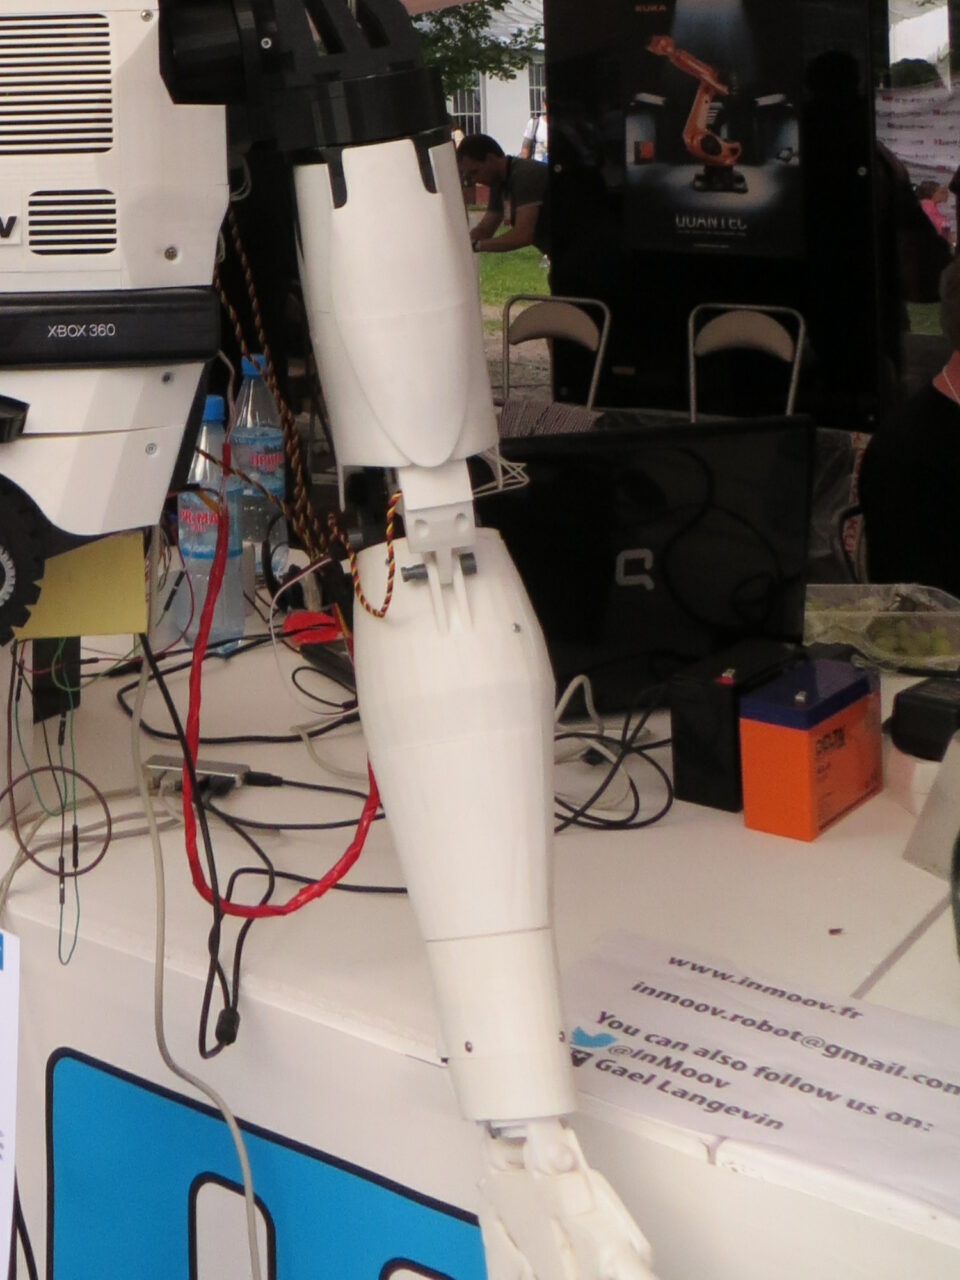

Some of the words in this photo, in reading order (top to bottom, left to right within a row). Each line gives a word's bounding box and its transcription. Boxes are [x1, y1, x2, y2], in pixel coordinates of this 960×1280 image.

[47, 324, 86, 339] XBOX
[88, 323, 116, 338] 360
[667, 954, 864, 1022] www.inmoov.fr
[594, 1056, 655, 1088] Gael
[655, 1077, 786, 1132] Langevin
[595, 1010, 640, 1038] You
[644, 1030, 688, 1053] can
[693, 1042, 748, 1073] also
[752, 1064, 842, 1104] follow
[846, 1095, 880, 1117] us
[884, 1107, 936, 1133] on:
[607, 1042, 732, 1091] @InMoov
